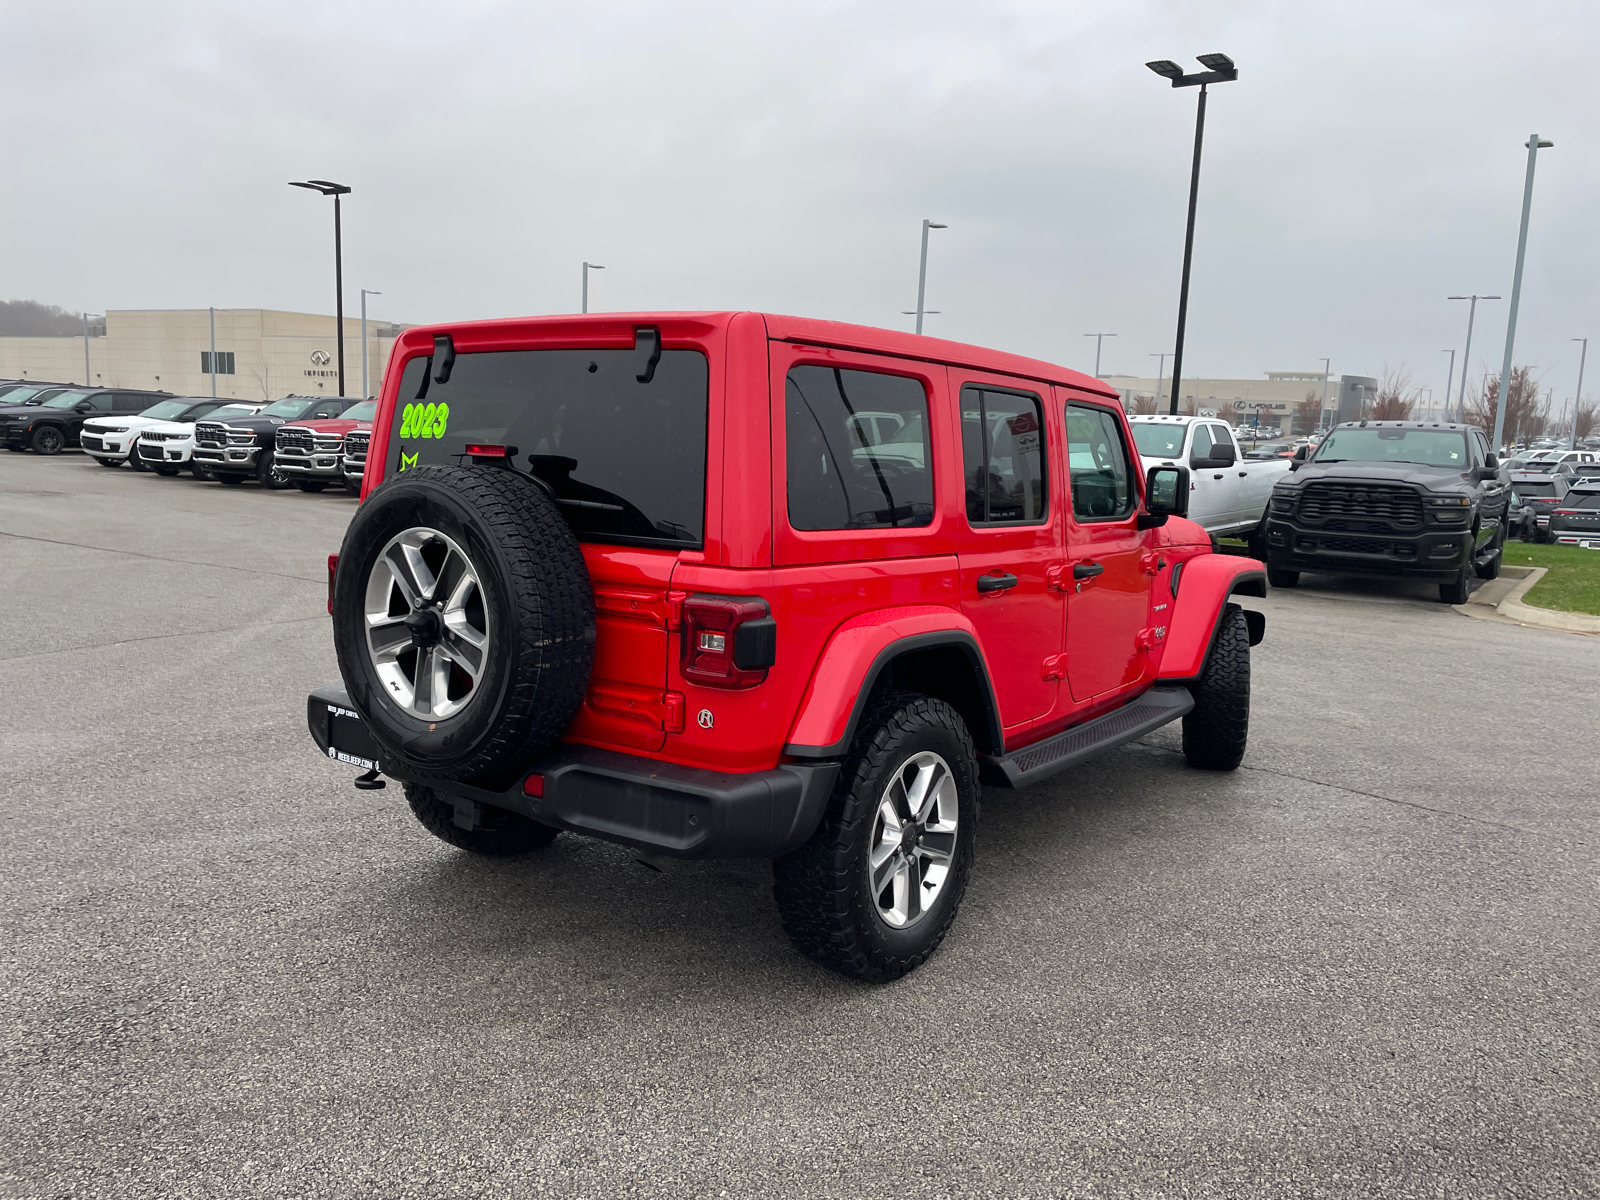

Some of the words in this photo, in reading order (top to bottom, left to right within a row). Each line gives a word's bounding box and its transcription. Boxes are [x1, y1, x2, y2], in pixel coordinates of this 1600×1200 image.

[303, 369, 338, 378] INFINITI
[1249, 402, 1286, 410] LEXUS
[400, 402, 449, 439] 2023
